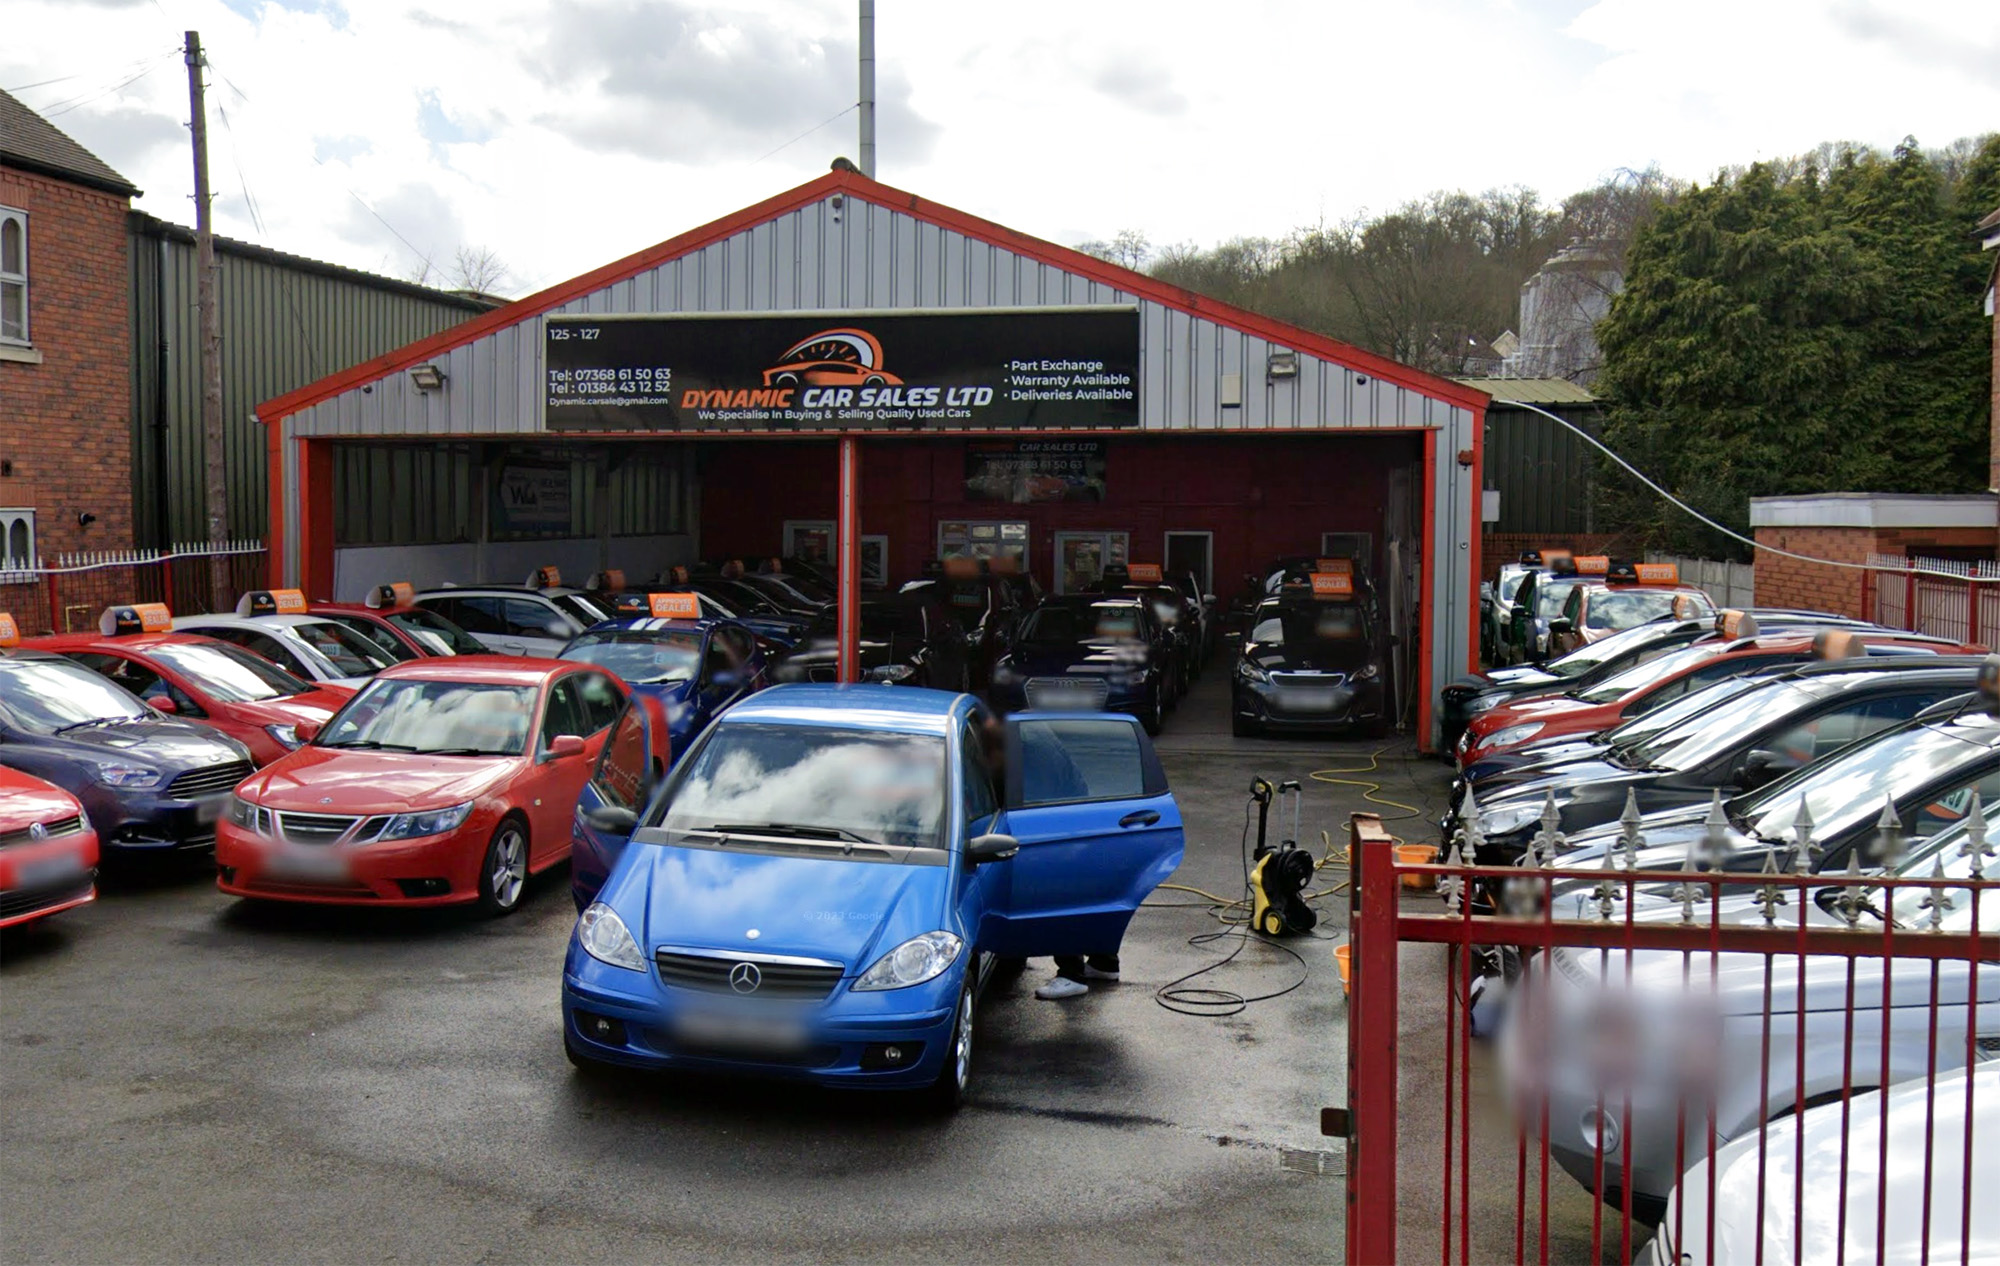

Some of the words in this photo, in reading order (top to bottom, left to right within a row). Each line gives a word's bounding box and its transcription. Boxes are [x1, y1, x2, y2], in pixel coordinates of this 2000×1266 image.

[550, 329, 570, 340] 125
[580, 328, 600, 340] 127
[1011, 360, 1038, 371] Part
[1041, 359, 1103, 373] Exchange
[549, 369, 572, 382] Tel:
[575, 369, 616, 381] 07368
[618, 369, 632, 380] 61
[635, 369, 652, 380] 50
[654, 368, 671, 380] 63
[1011, 375, 1070, 388] Warranty
[1072, 374, 1130, 385] Available
[549, 382, 568, 394] Tel
[578, 382, 616, 394] 01384
[619, 381, 636, 393] 43
[639, 381, 652, 393] 12
[654, 381, 671, 392] 52
[681, 388, 795, 409] DYNAMIC
[803, 387, 854, 408] CAR
[858, 387, 941, 407] SALES
[946, 387, 994, 406] LTD
[1011, 389, 1073, 401] Deliveries
[1075, 389, 1133, 400] Available
[549, 397, 669, 407] Dynamic.carsale@gmail.com
[698, 411, 716, 420] We
[717, 410, 770, 421] Specialise
[771, 410, 783, 420] In
[784, 410, 823, 421] Buying
[824, 411, 833, 419] &
[838, 409, 874, 420] Selling
[876, 408, 916, 420] Quality
[917, 408, 945, 418] Used
[946, 408, 972, 418] Cars
[1042, 442, 1076, 451] SALES
[1077, 442, 1098, 451] LTD
[655, 603, 693, 612] DEALER
